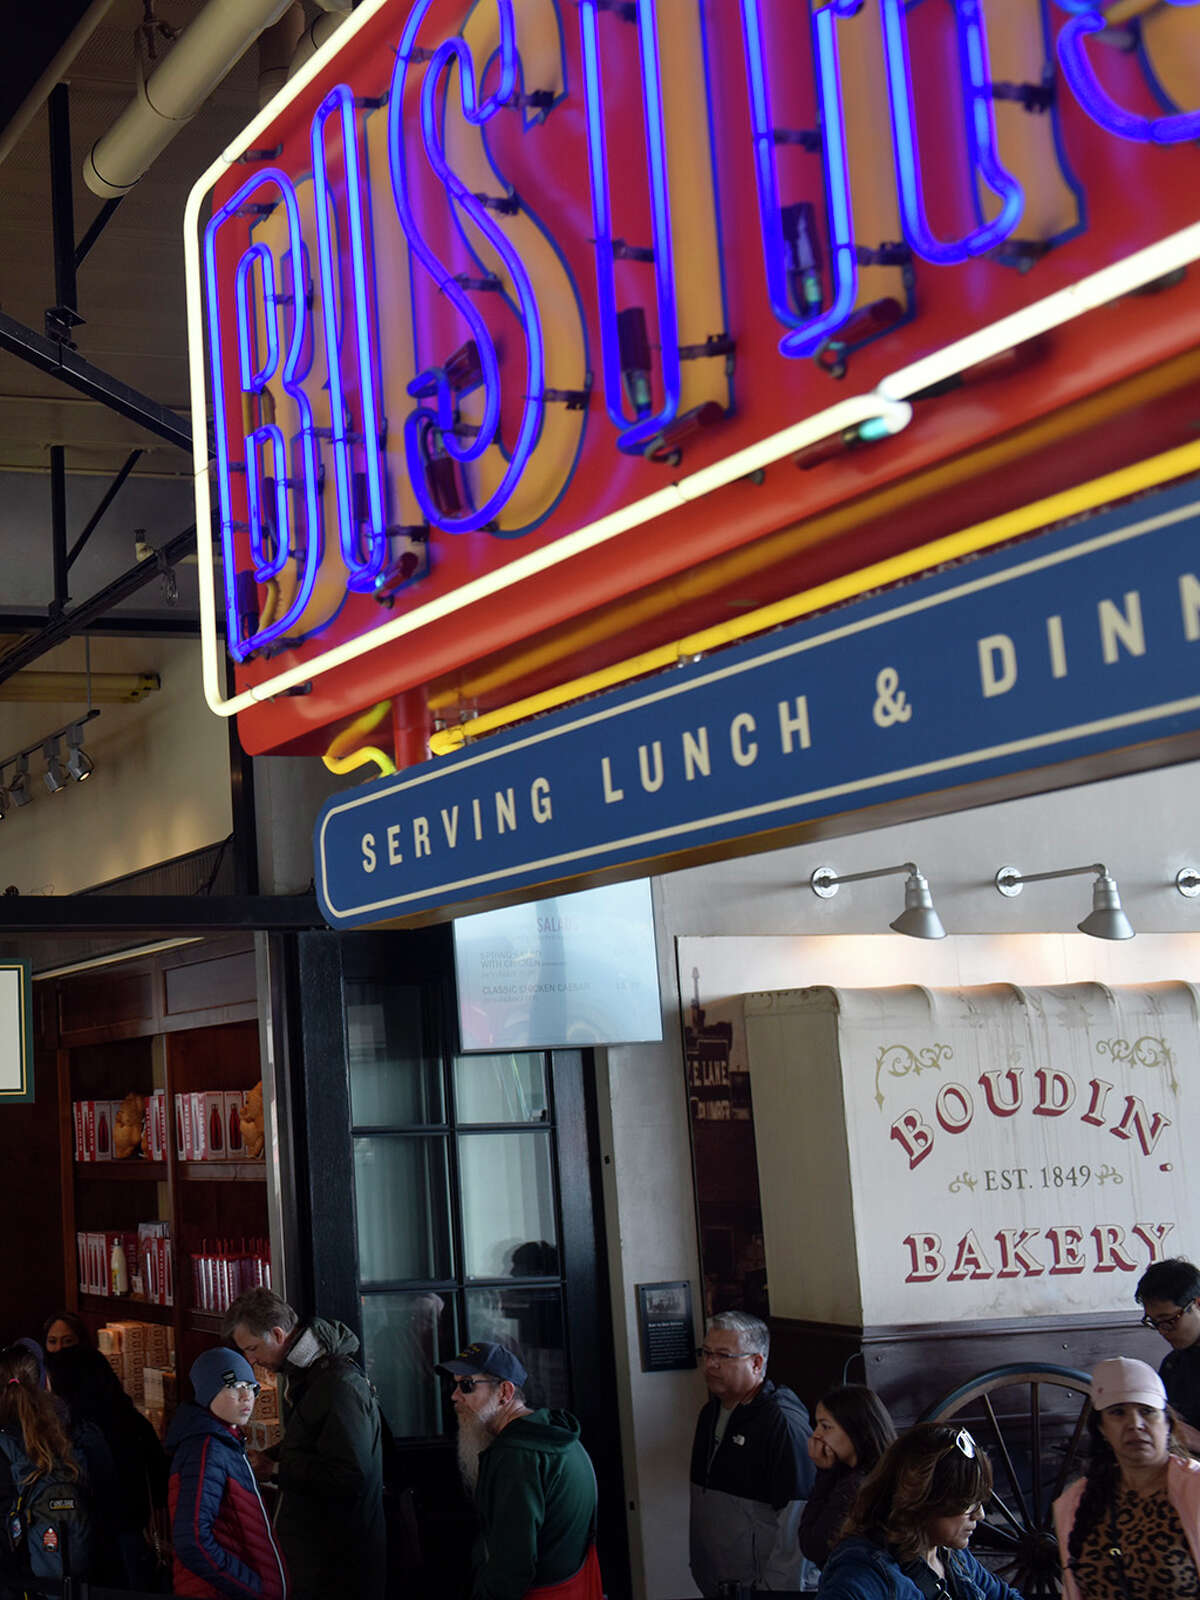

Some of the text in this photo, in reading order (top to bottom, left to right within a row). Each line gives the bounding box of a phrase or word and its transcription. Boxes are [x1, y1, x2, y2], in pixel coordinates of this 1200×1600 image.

[361, 776, 553, 874] SERVING
[602, 695, 811, 804] LUNCH
[873, 667, 912, 728] &
[984, 1165, 1092, 1192] EST. 1849
[902, 1223, 1176, 1284] BAKERY
